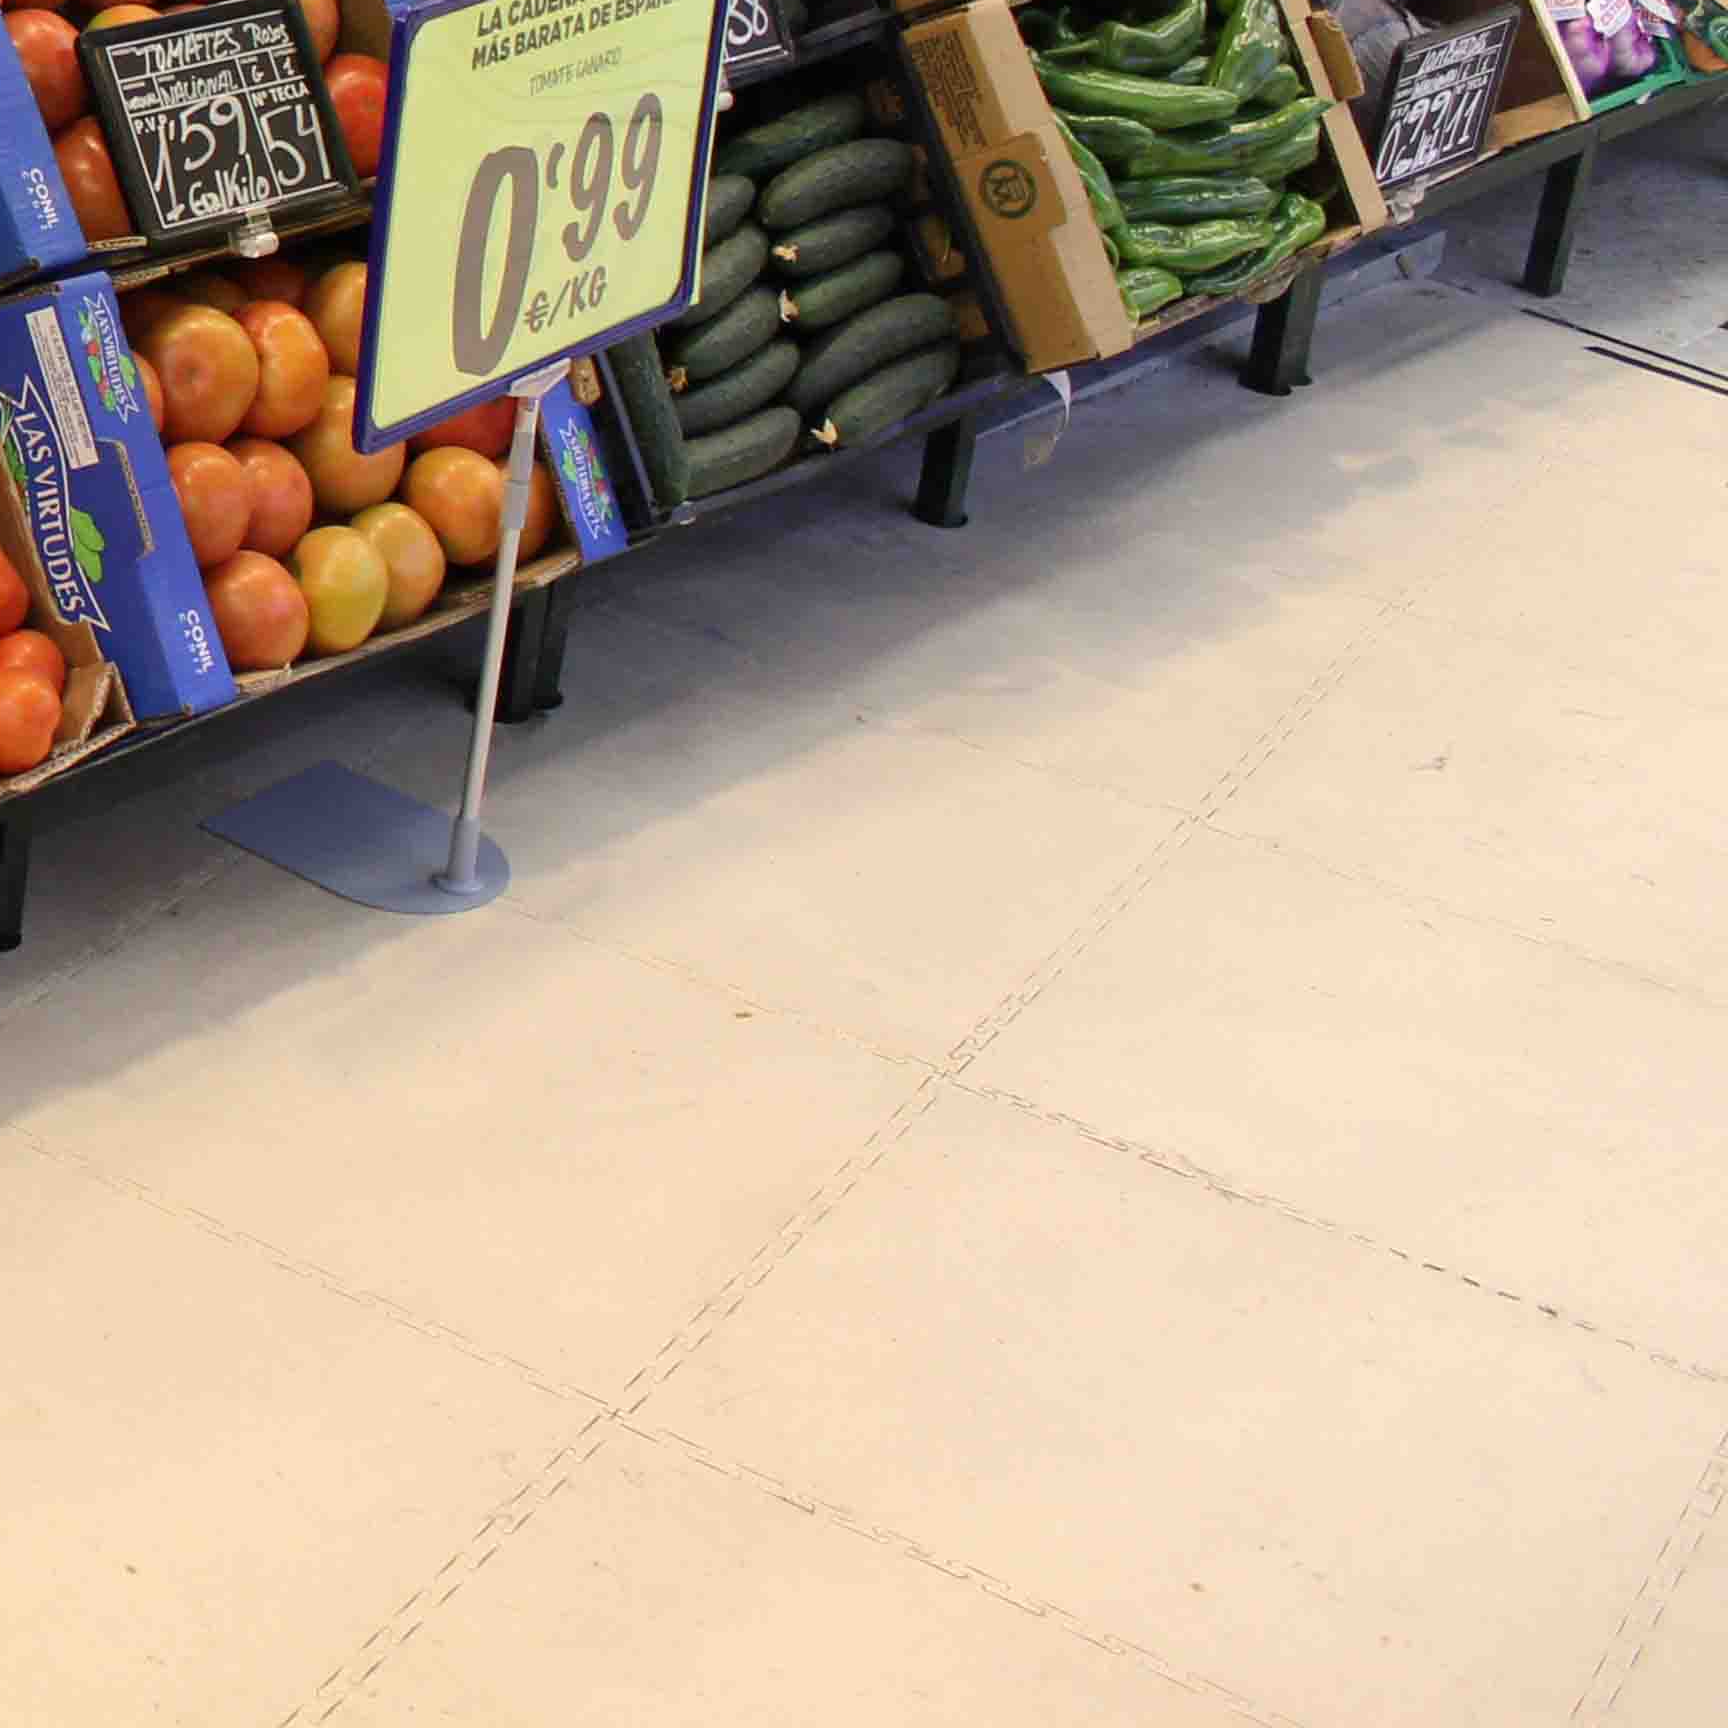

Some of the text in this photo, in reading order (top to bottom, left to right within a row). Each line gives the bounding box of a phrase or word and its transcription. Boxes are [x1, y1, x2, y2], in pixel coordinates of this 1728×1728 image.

[136, 28, 241, 72] TOMATES
[471, 34, 511, 71] MÁS
[513, 14, 586, 57] BARATA
[589, 5, 611, 32] DE
[476, 5, 504, 38] LA
[160, 70, 238, 108] NACIONAL
[269, 83, 310, 103] TECLA
[260, 104, 331, 186] 54
[30, 168, 59, 230] CONIL
[523, 265, 607, 335] €/KG
[102, 335, 128, 405] VIRTUDES
[14, 412, 53, 463] LAS
[33, 473, 85, 613] VIRTUDES
[185, 607, 215, 675] CONIL
